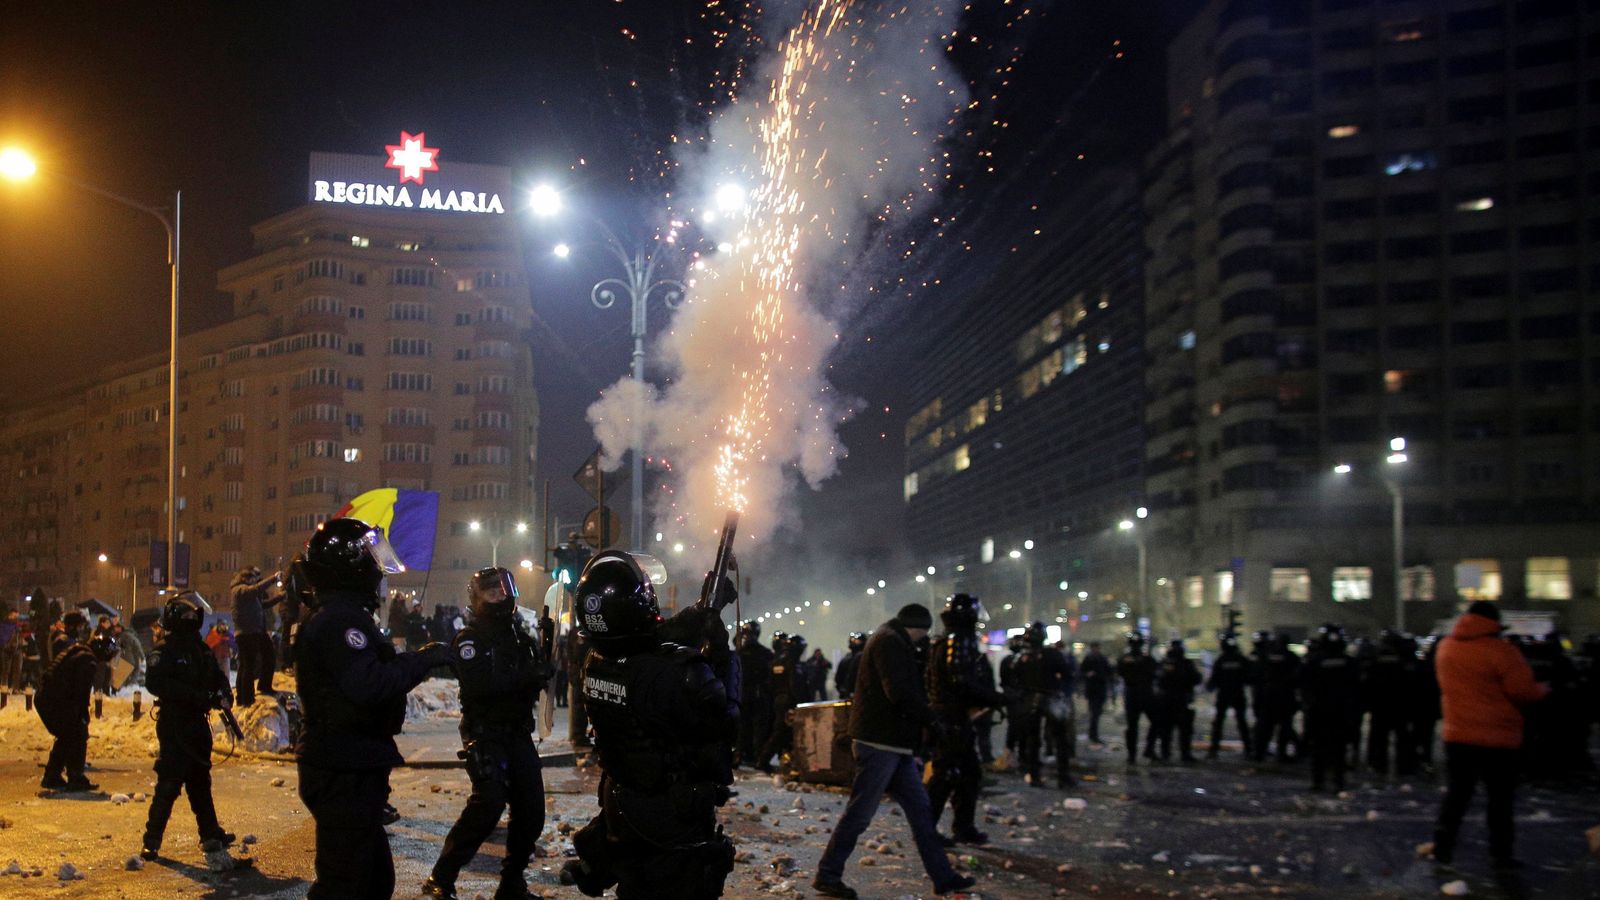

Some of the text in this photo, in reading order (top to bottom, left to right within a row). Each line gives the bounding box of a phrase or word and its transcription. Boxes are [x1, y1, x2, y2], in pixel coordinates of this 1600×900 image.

[314, 180, 504, 214] REGINA MARIA
[584, 614, 604, 623] BS2
[584, 677, 627, 698] NDARMERIA
